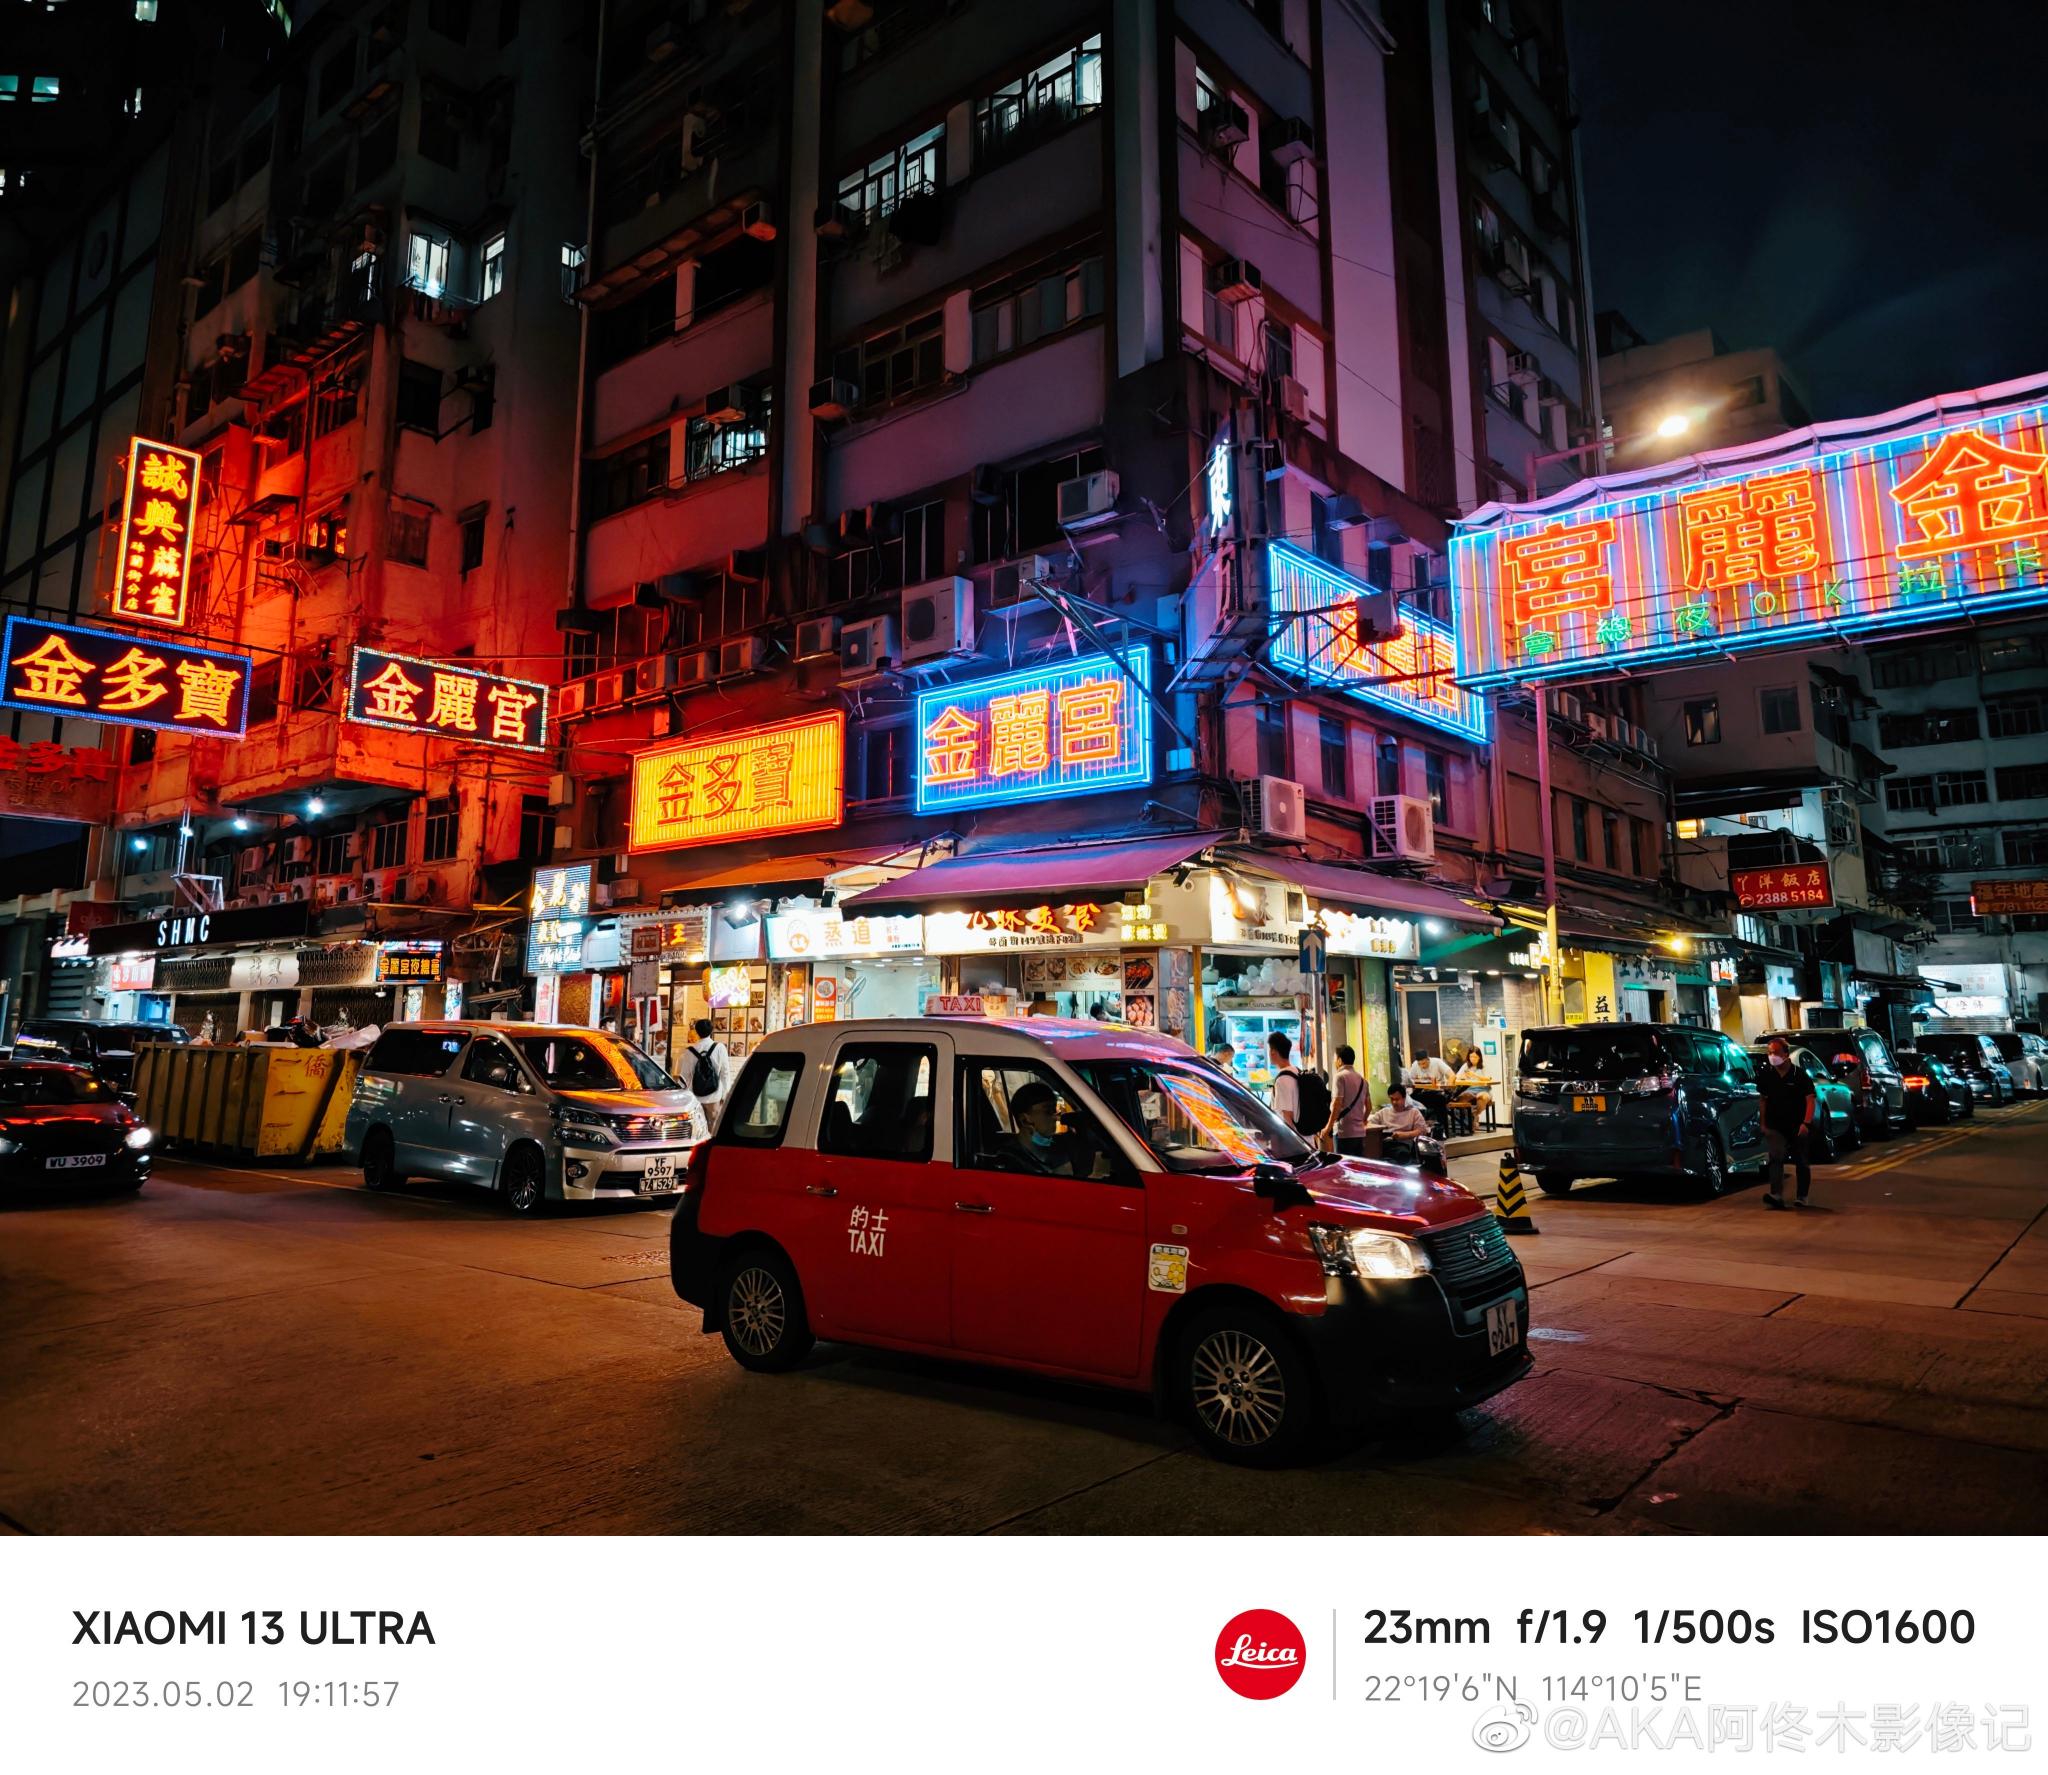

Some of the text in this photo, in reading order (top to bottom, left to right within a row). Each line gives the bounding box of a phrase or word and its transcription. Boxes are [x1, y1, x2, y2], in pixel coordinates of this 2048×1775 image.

[11, 634, 242, 727] 金多寶
[657, 740, 795, 827] 金多寶
[1756, 889, 1824, 905] 2388 5184
[158, 914, 210, 946] SHMC
[939, 996, 982, 1012] TAXI
[71, 1155, 103, 1166] 3909
[647, 1166, 672, 1177] 9597
[654, 1157, 667, 1167] YF
[850, 1204, 889, 1232] 的士
[847, 1228, 885, 1257] TAXI
